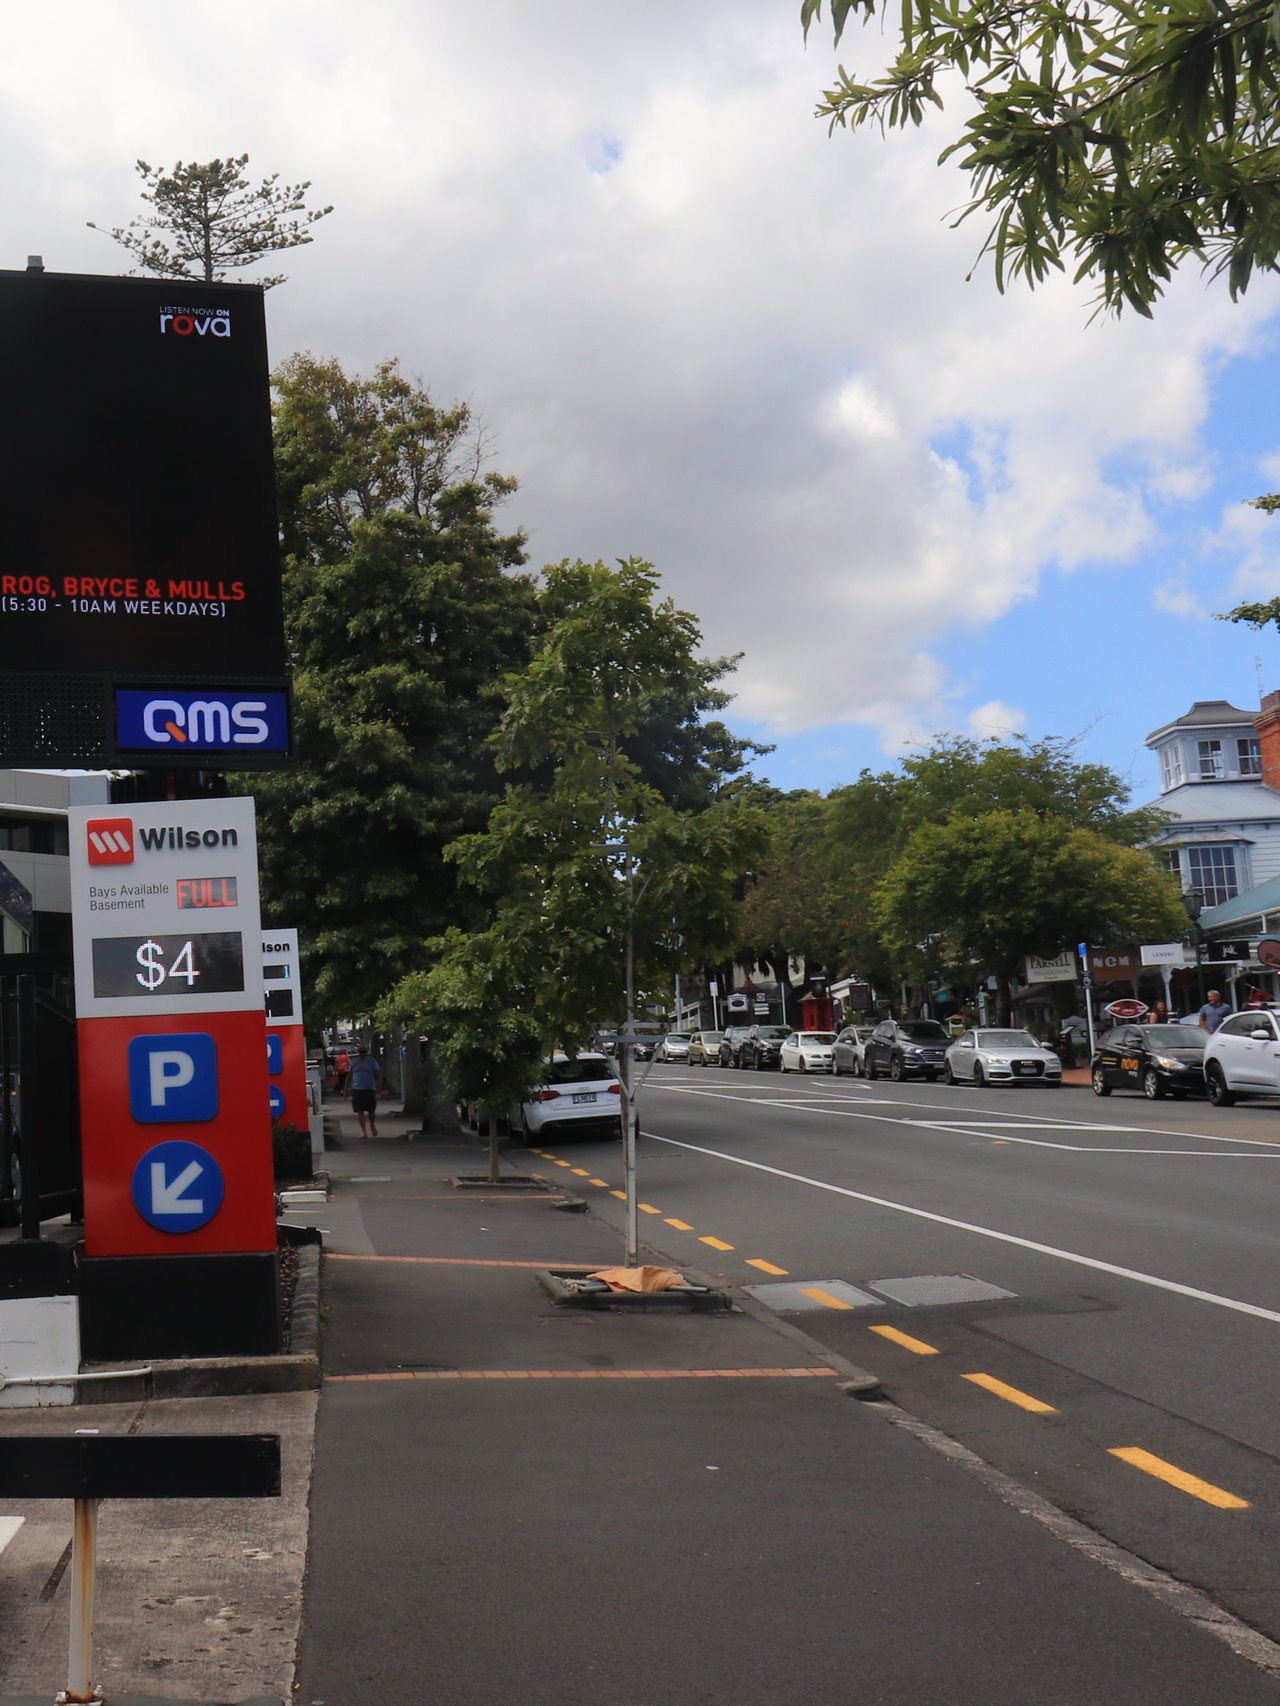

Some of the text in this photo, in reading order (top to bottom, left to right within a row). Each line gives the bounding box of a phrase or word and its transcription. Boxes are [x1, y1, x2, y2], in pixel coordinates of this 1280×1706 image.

[160, 306, 230, 317] LISTEN NOW ON
[160, 314, 231, 337] rova
[1, 575, 246, 601] ROG, BRYCE & MULLS
[70, 599, 117, 614] 10AM
[139, 826, 238, 850] Wilson
[89, 883, 169, 899] Bays Available
[176, 879, 238, 909] FULL
[90, 899, 145, 911] Basement
[135, 939, 200, 991] $4
[1092, 956, 1130, 967] NCM
[148, 1051, 195, 1106] P
